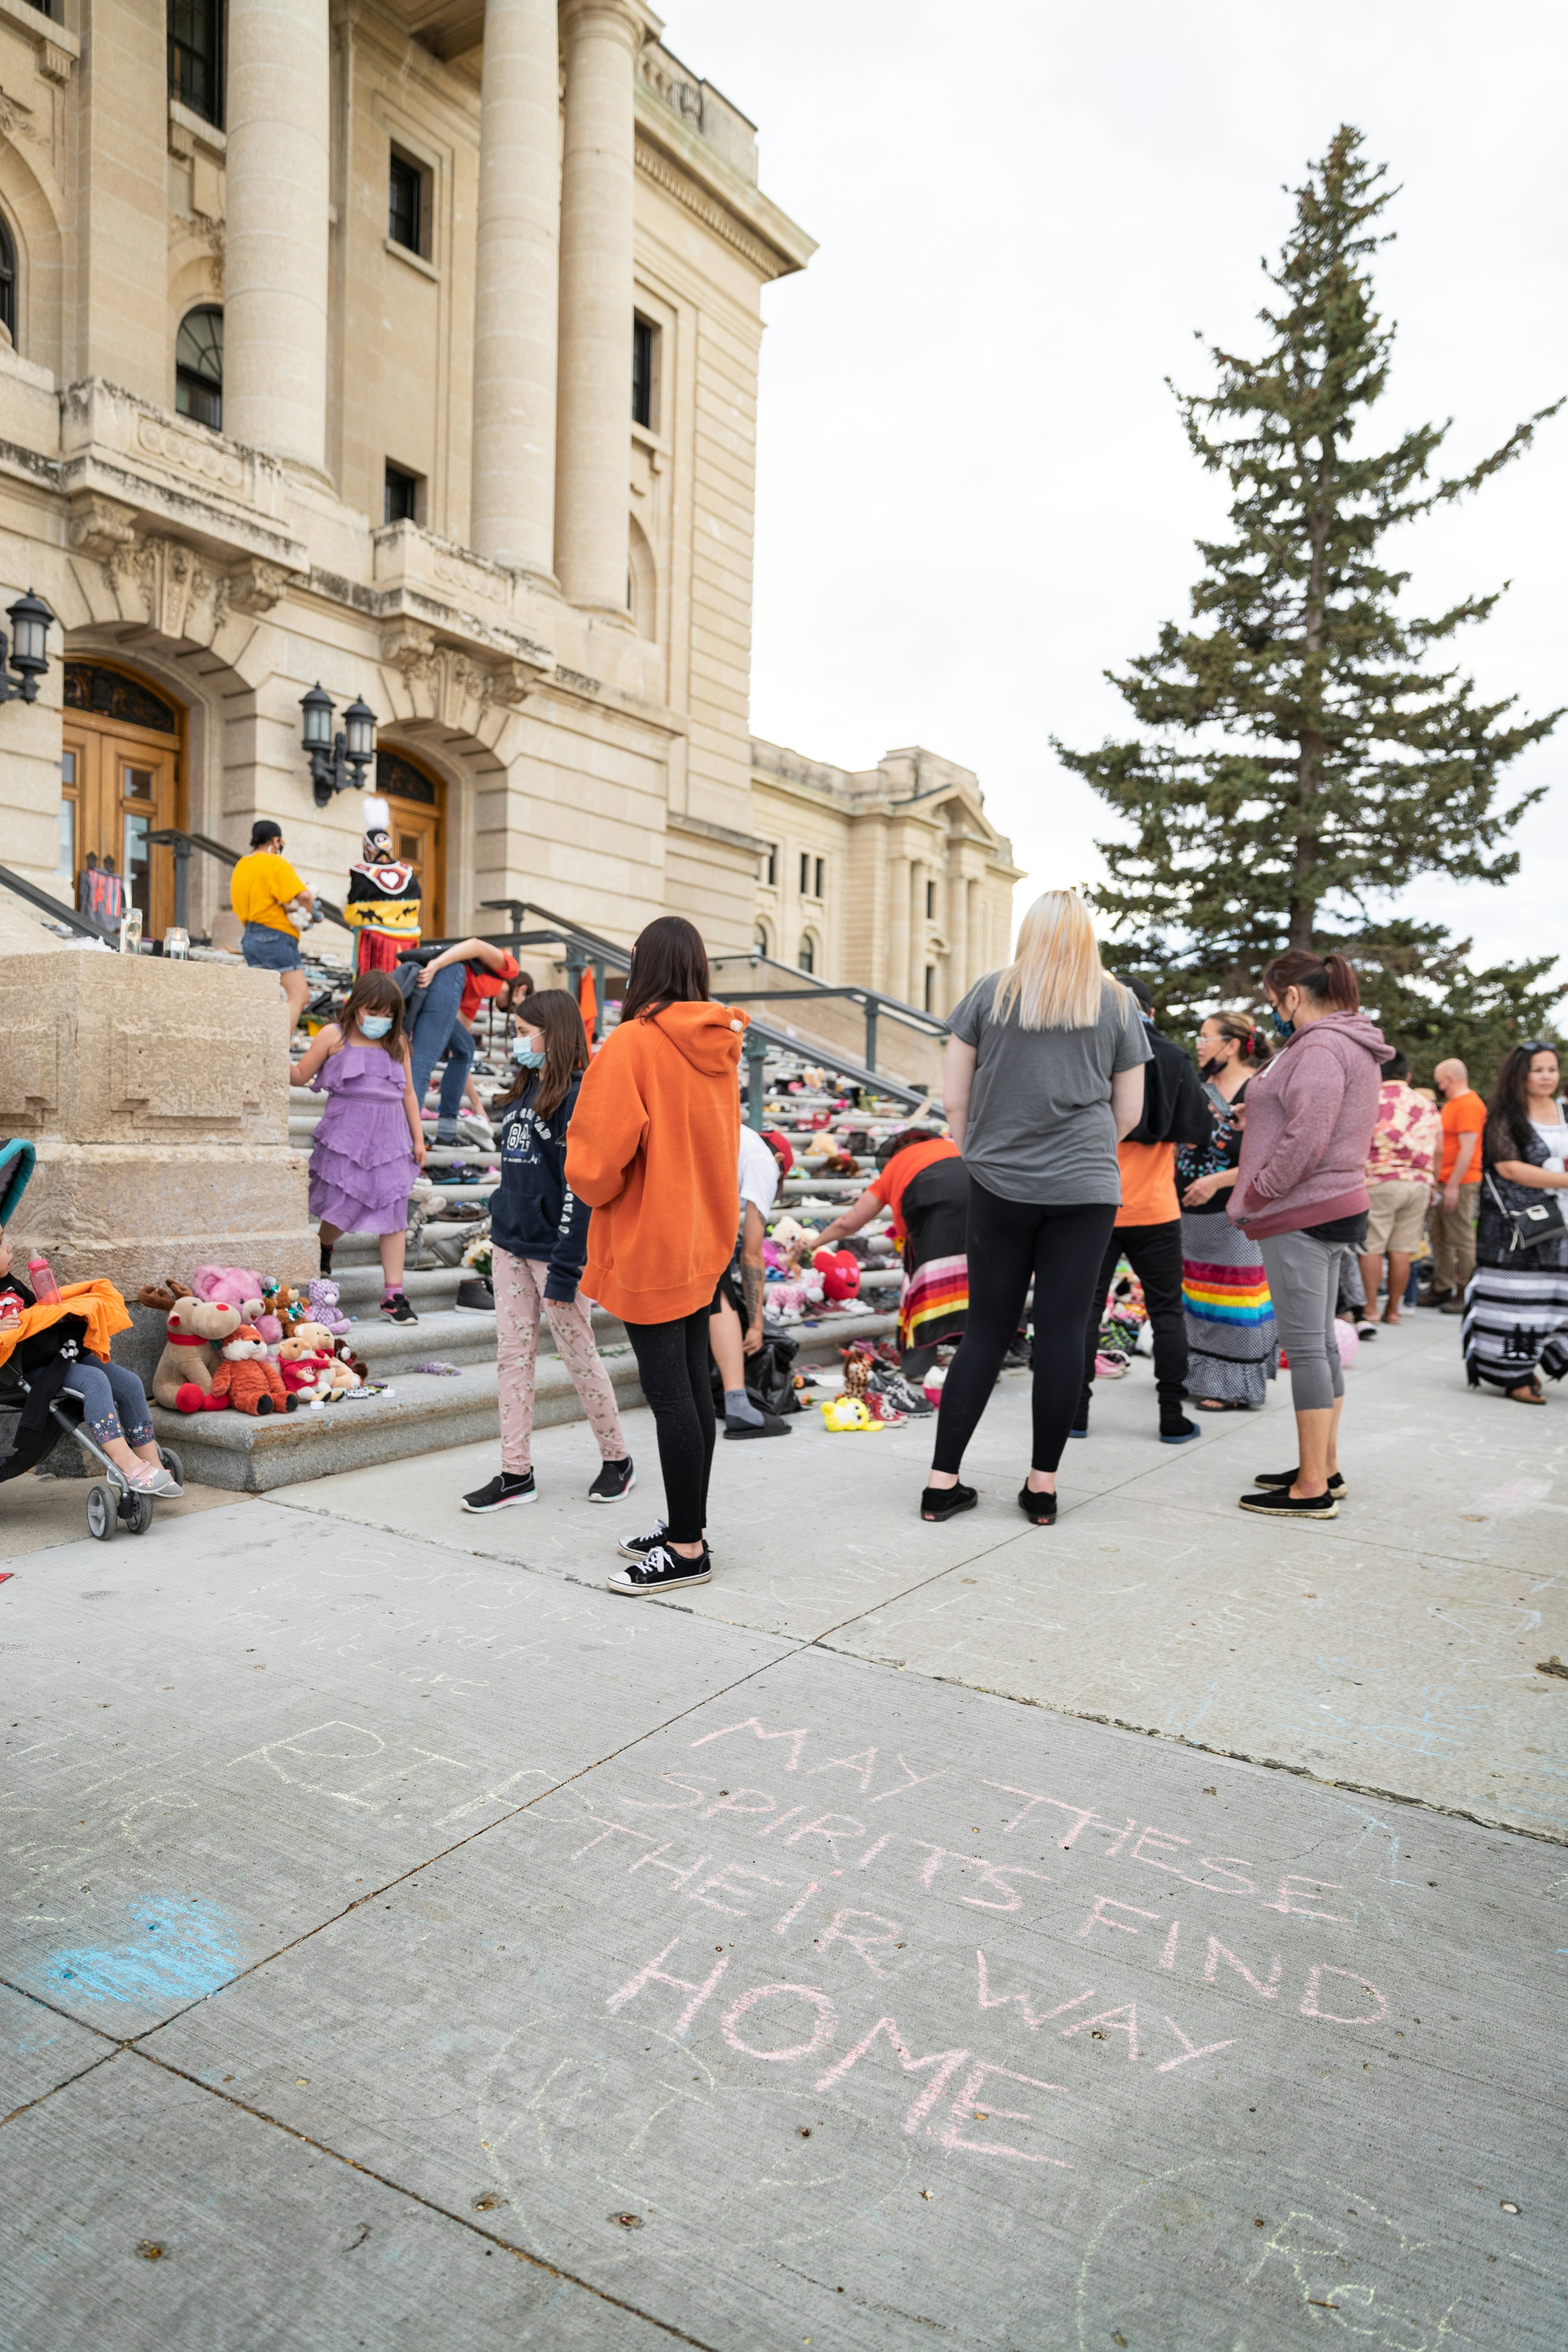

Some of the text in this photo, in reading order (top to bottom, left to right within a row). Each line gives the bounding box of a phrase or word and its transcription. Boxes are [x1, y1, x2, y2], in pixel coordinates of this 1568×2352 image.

[507, 1123, 531, 1152] 84
[621, 1771, 1391, 2026] SPIRITS FIND
[690, 1716, 1352, 1923] MAY THESE
[605, 1937, 1076, 2169] HOME
[975, 1949, 1239, 2074] WAY
